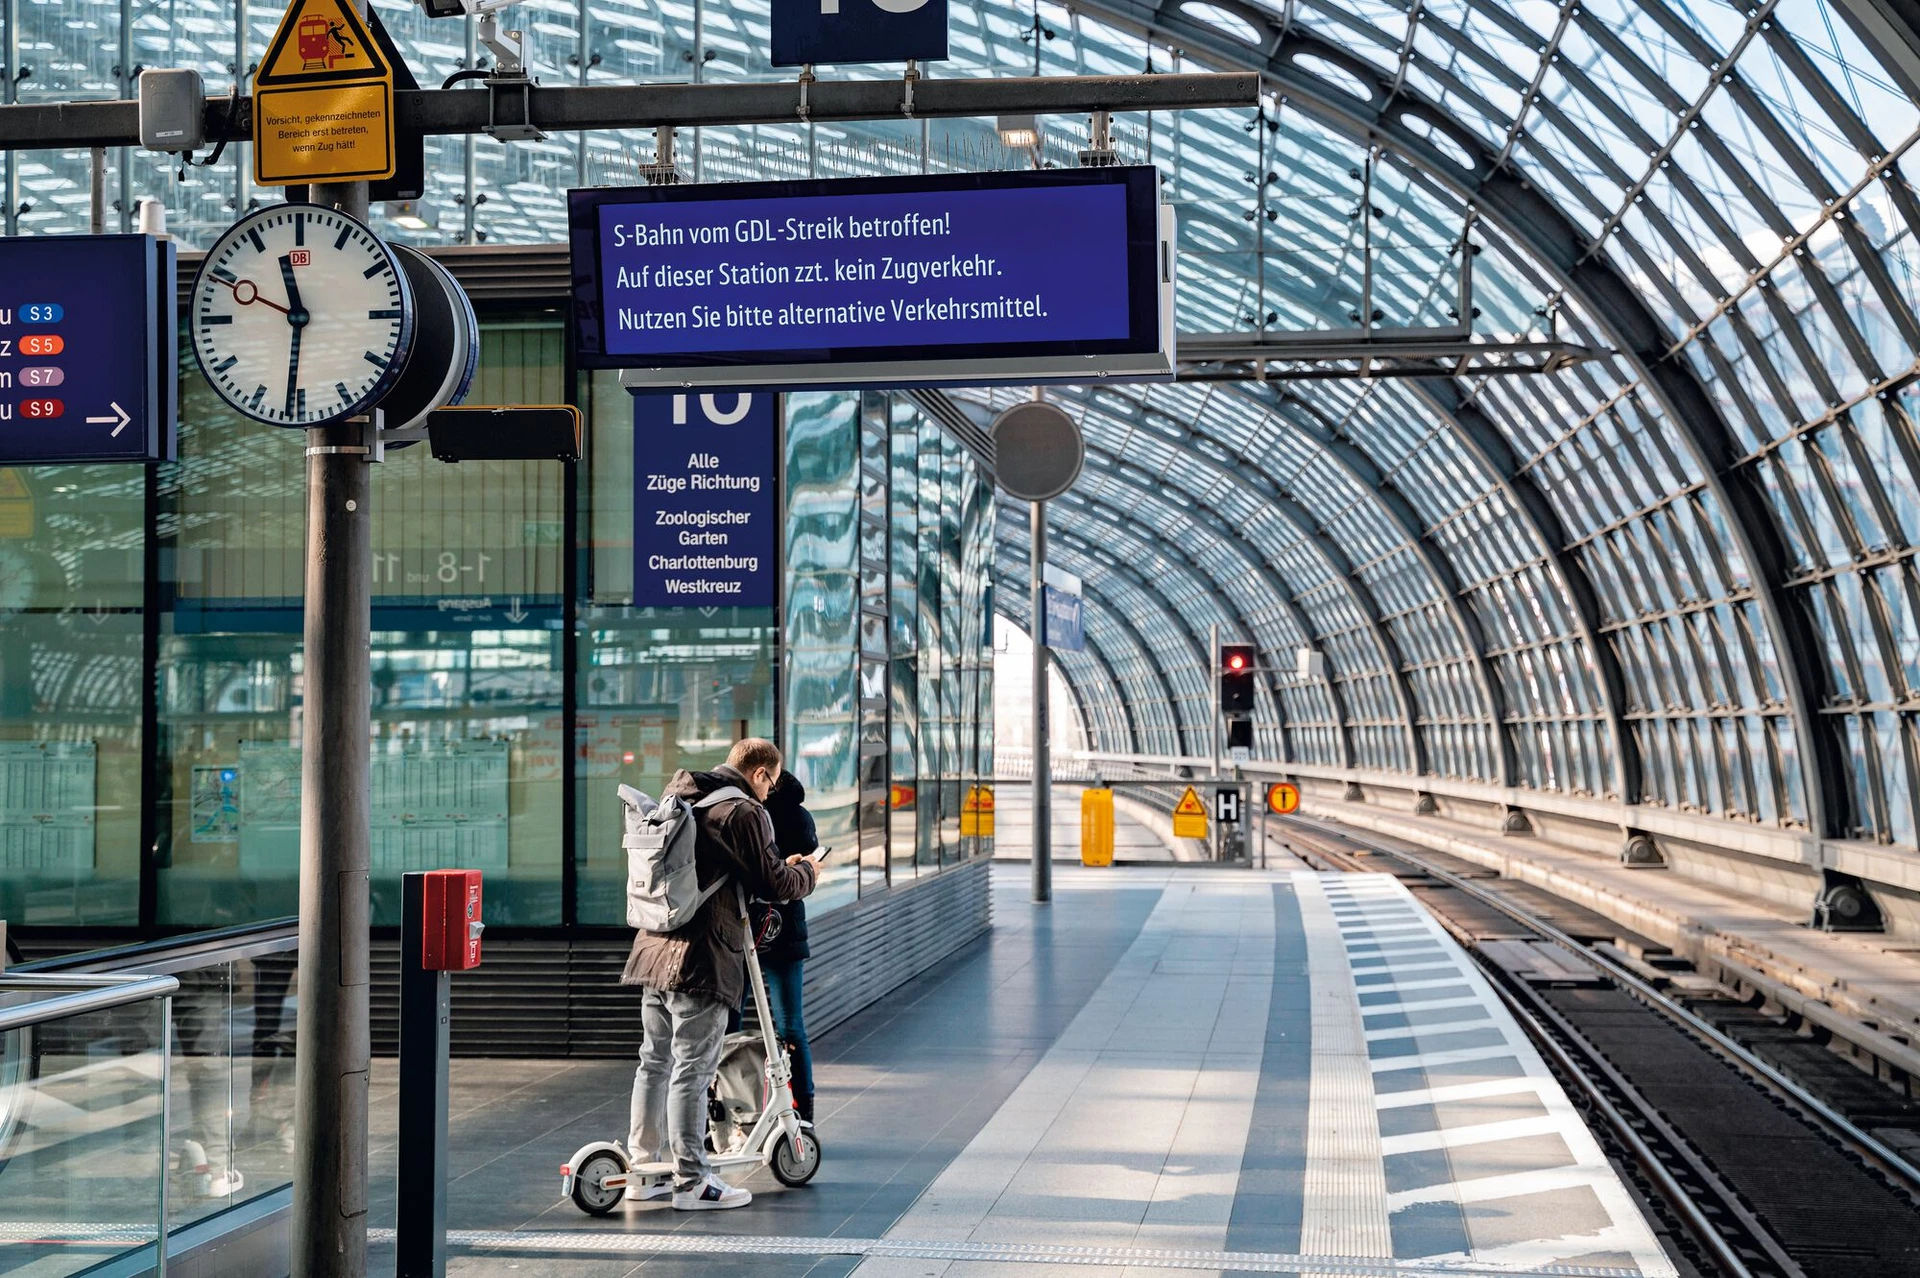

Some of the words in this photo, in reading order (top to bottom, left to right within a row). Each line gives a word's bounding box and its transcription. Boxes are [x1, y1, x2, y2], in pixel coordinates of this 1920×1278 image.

[266, 115, 302, 126] Vorsicht,
[305, 109, 381, 124] gekennzeichneten
[278, 129, 310, 139] Bereich
[312, 127, 329, 137] erst
[331, 125, 369, 136] betreten,
[292, 143, 315, 153] wenn
[318, 142, 334, 152] Zug
[336, 140, 355, 150] hält!
[614, 223, 684, 247] S-Bahn
[689, 225, 729, 244] vom
[735, 216, 844, 242] GDL-Streik
[850, 212, 951, 238] betroffen!
[291, 252, 308, 265] DB
[616, 265, 649, 289] Auf
[655, 264, 714, 288] dieser
[719, 262, 789, 286] Station
[795, 261, 829, 283] zzt.
[835, 258, 876, 282] kein
[881, 253, 1002, 284] Zugverkehr.
[618, 307, 687, 330] Nutzen
[692, 305, 721, 328] Sie
[726, 304, 773, 327] bitte
[778, 300, 886, 325] alternative
[891, 294, 1048, 321] Verkehrsmittel.
[687, 453, 719, 469] Alle
[647, 474, 687, 494] Züge
[691, 473, 760, 492] Richtung
[655, 510, 751, 528] Zoologischer
[678, 530, 728, 546] Garten
[648, 554, 758, 572] Charlottenburg
[665, 579, 742, 594] Westkreuz
[1218, 793, 1237, 820] H
